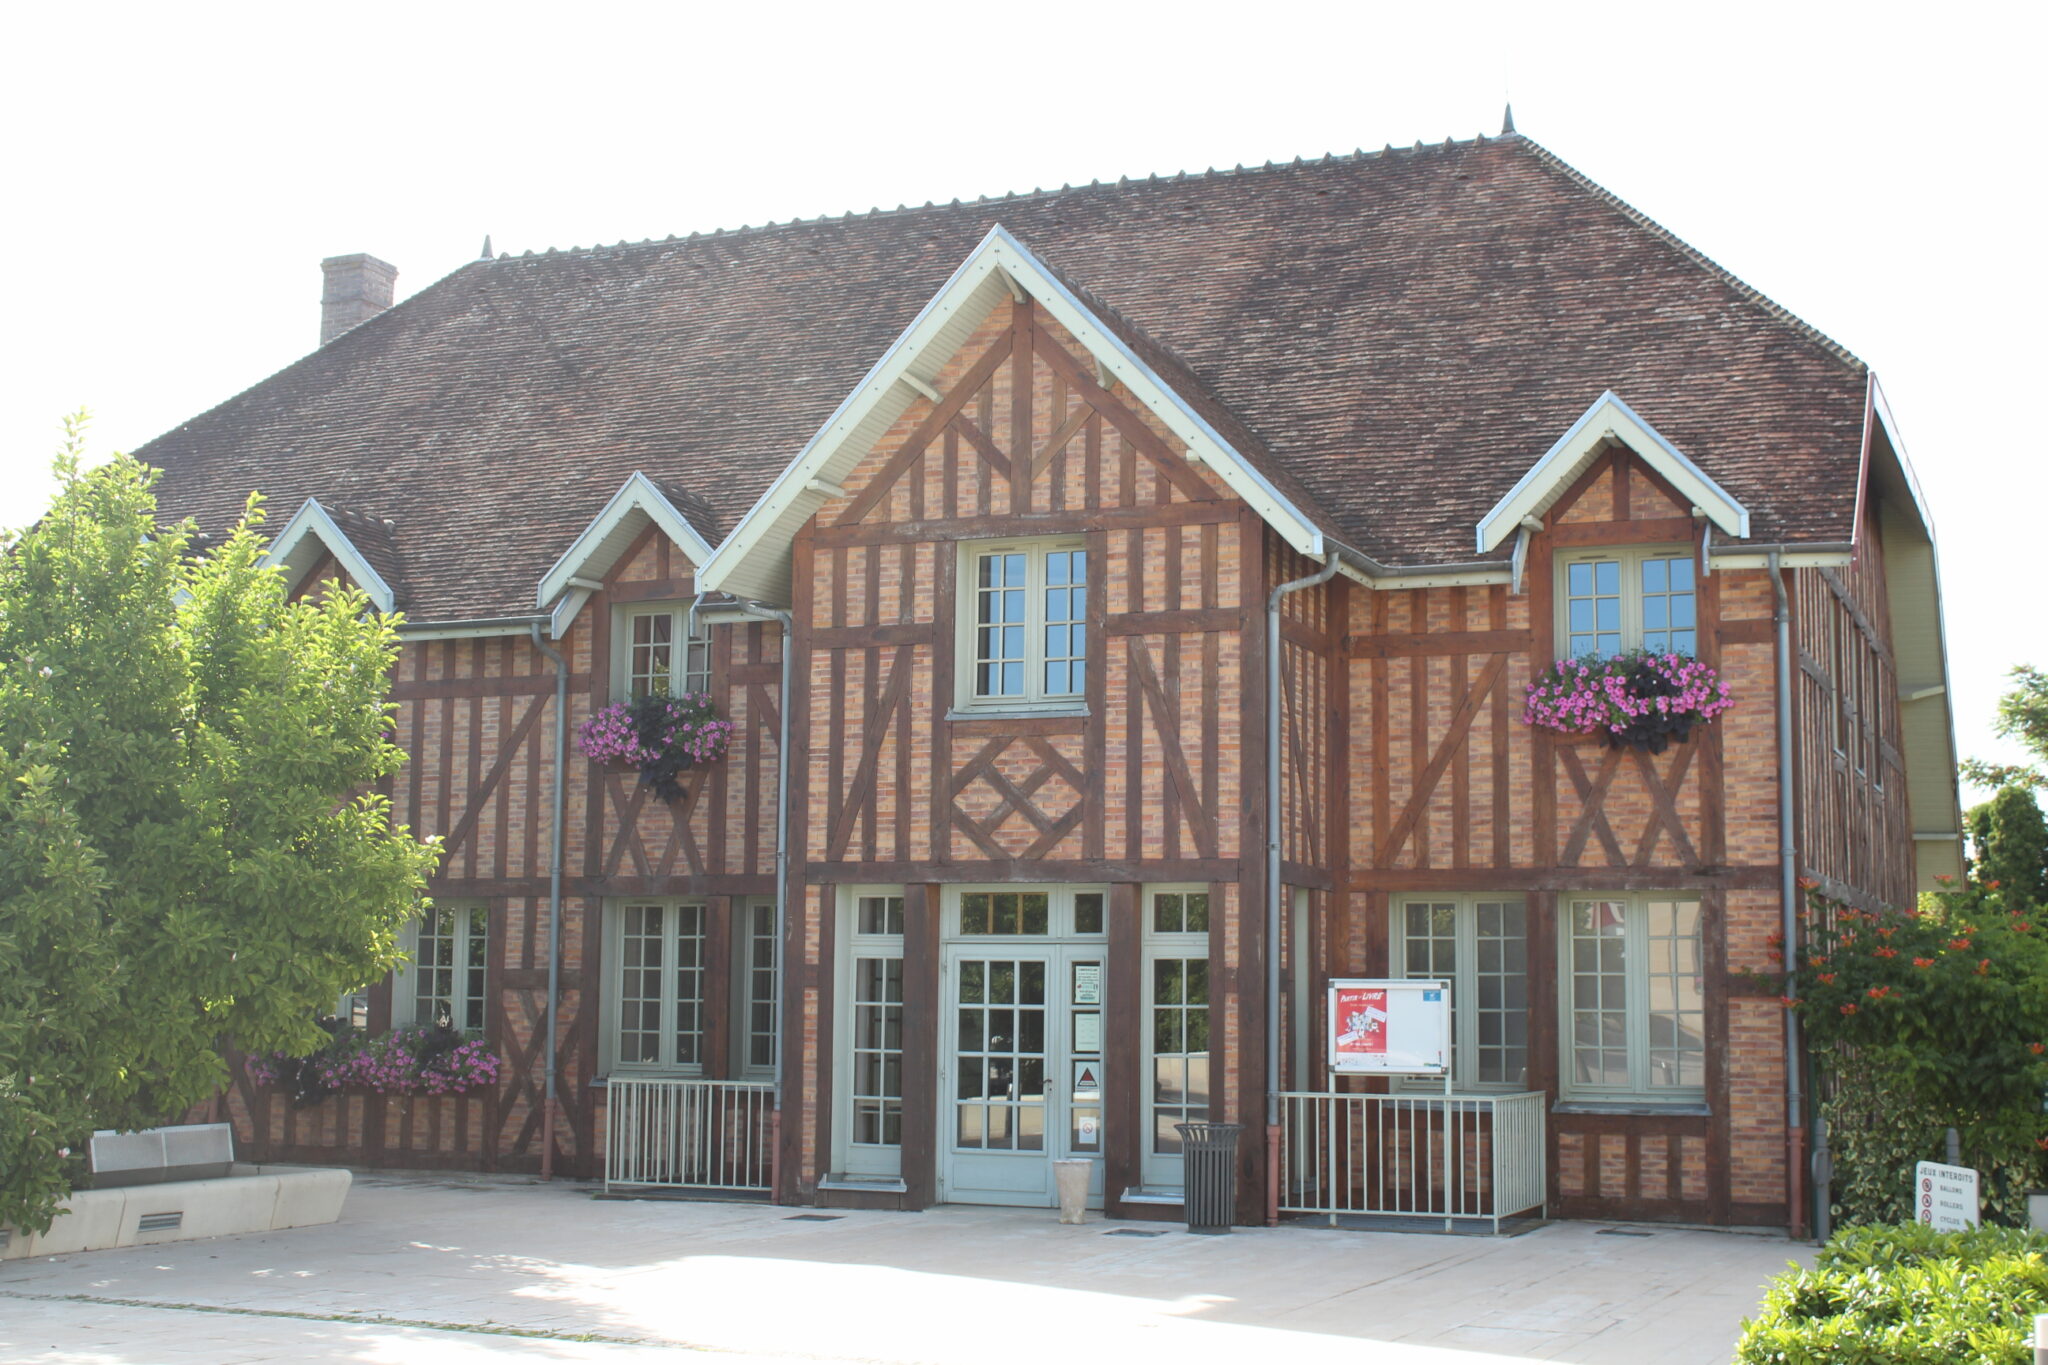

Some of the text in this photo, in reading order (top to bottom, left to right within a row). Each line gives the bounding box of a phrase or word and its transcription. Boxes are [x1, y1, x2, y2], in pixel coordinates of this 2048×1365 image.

[1920, 1167, 1973, 1183] JEUX INTERDITS
[1940, 1185, 1962, 1194] BALLONS
[1940, 1200, 1963, 1210] ROLLERS
[1940, 1216, 1960, 1225] CYCLOS
